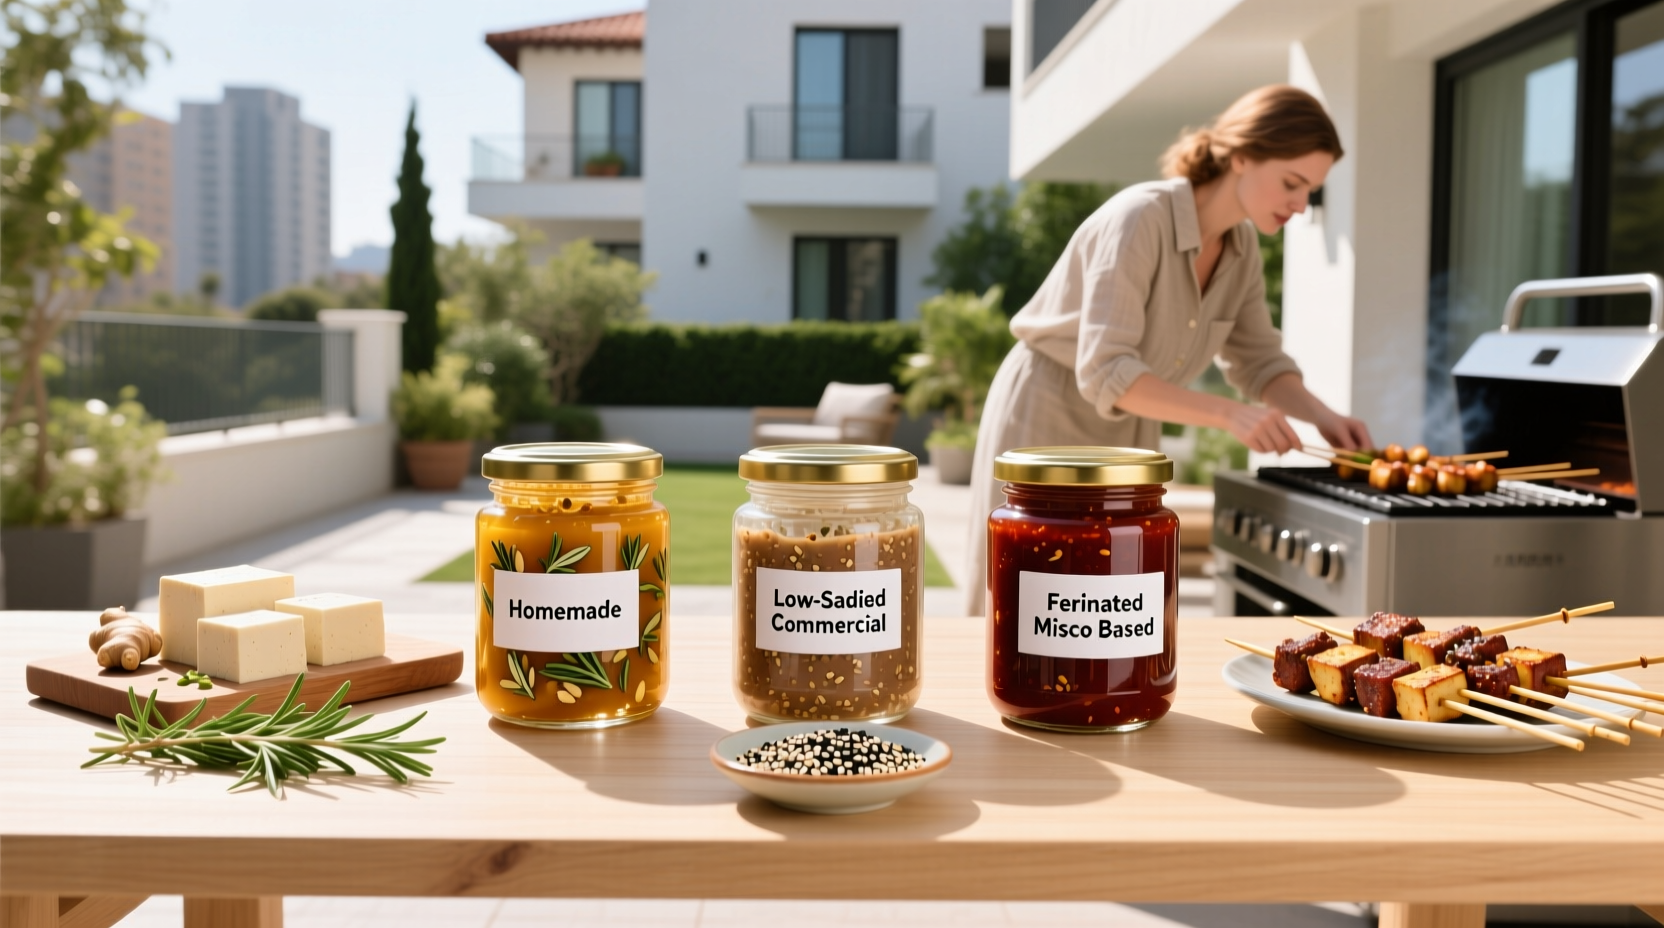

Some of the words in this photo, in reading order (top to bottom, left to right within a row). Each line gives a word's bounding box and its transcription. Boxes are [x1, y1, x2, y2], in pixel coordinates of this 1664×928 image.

[774, 587, 886, 609] Low-Sadied
[1047, 592, 1143, 613] Ferinated
[509, 598, 622, 621] Homemade
[771, 612, 886, 634] Commercial
[1034, 615, 1093, 639] Misco
[1098, 616, 1154, 639] Based
